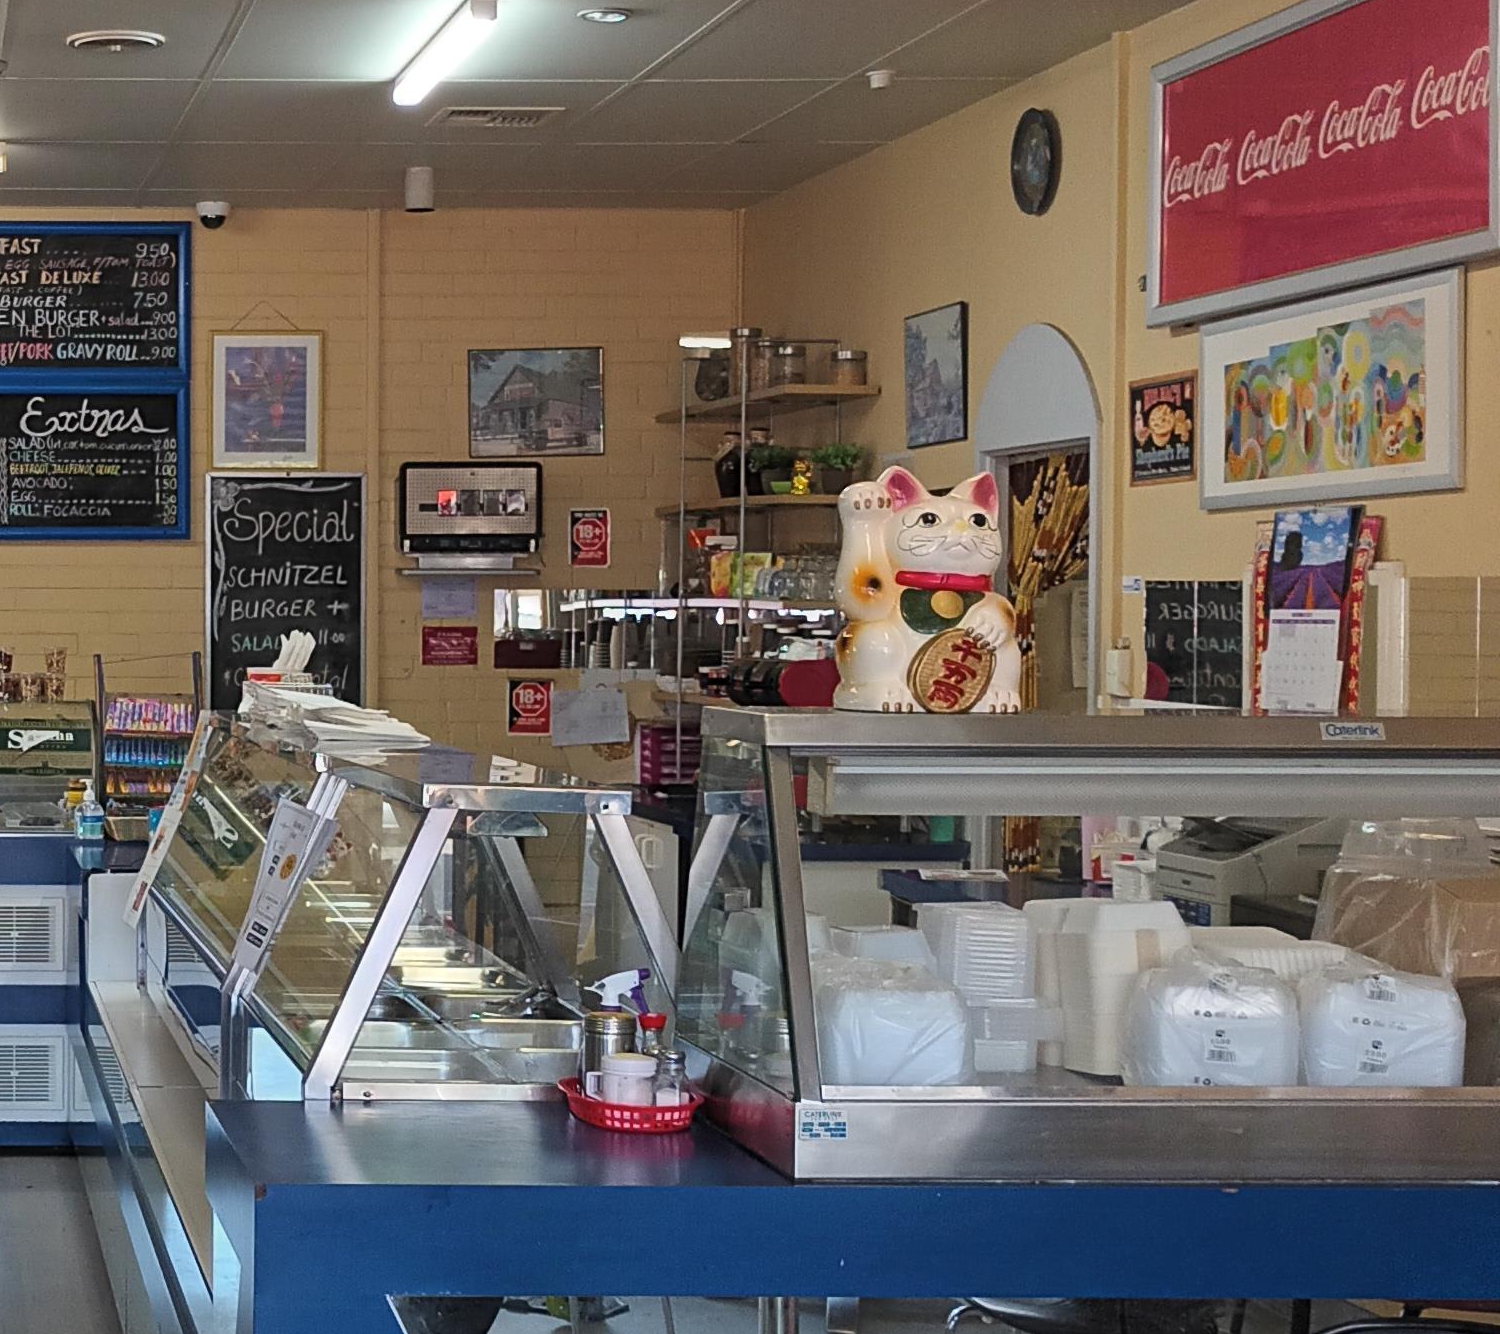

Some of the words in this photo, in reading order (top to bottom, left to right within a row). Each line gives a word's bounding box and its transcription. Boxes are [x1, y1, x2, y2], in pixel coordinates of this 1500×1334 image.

[1318, 79, 1406, 159] Coca-Cola
[1236, 110, 1314, 185] Coca-Cola
[1164, 138, 1231, 208] Coca-Cola
[0, 294, 68, 308] BURGER
[35, 310, 100, 327] BURGER
[56, 342, 105, 361] GRAVY
[106, 344, 139, 361] ROLL
[19, 396, 169, 437] Extras
[9, 451, 56, 463] CHEESE
[11, 490, 36, 503] EGG
[43, 505, 112, 517] FOCACCIA
[223, 497, 355, 555] Special
[577, 524, 603, 539] 18+
[226, 561, 348, 587] SCHNITZEL
[230, 599, 316, 621] BURGER
[327, 599, 349, 616] +
[517, 688, 545, 705] 18+
[1325, 723, 1380, 737] Caterlink
